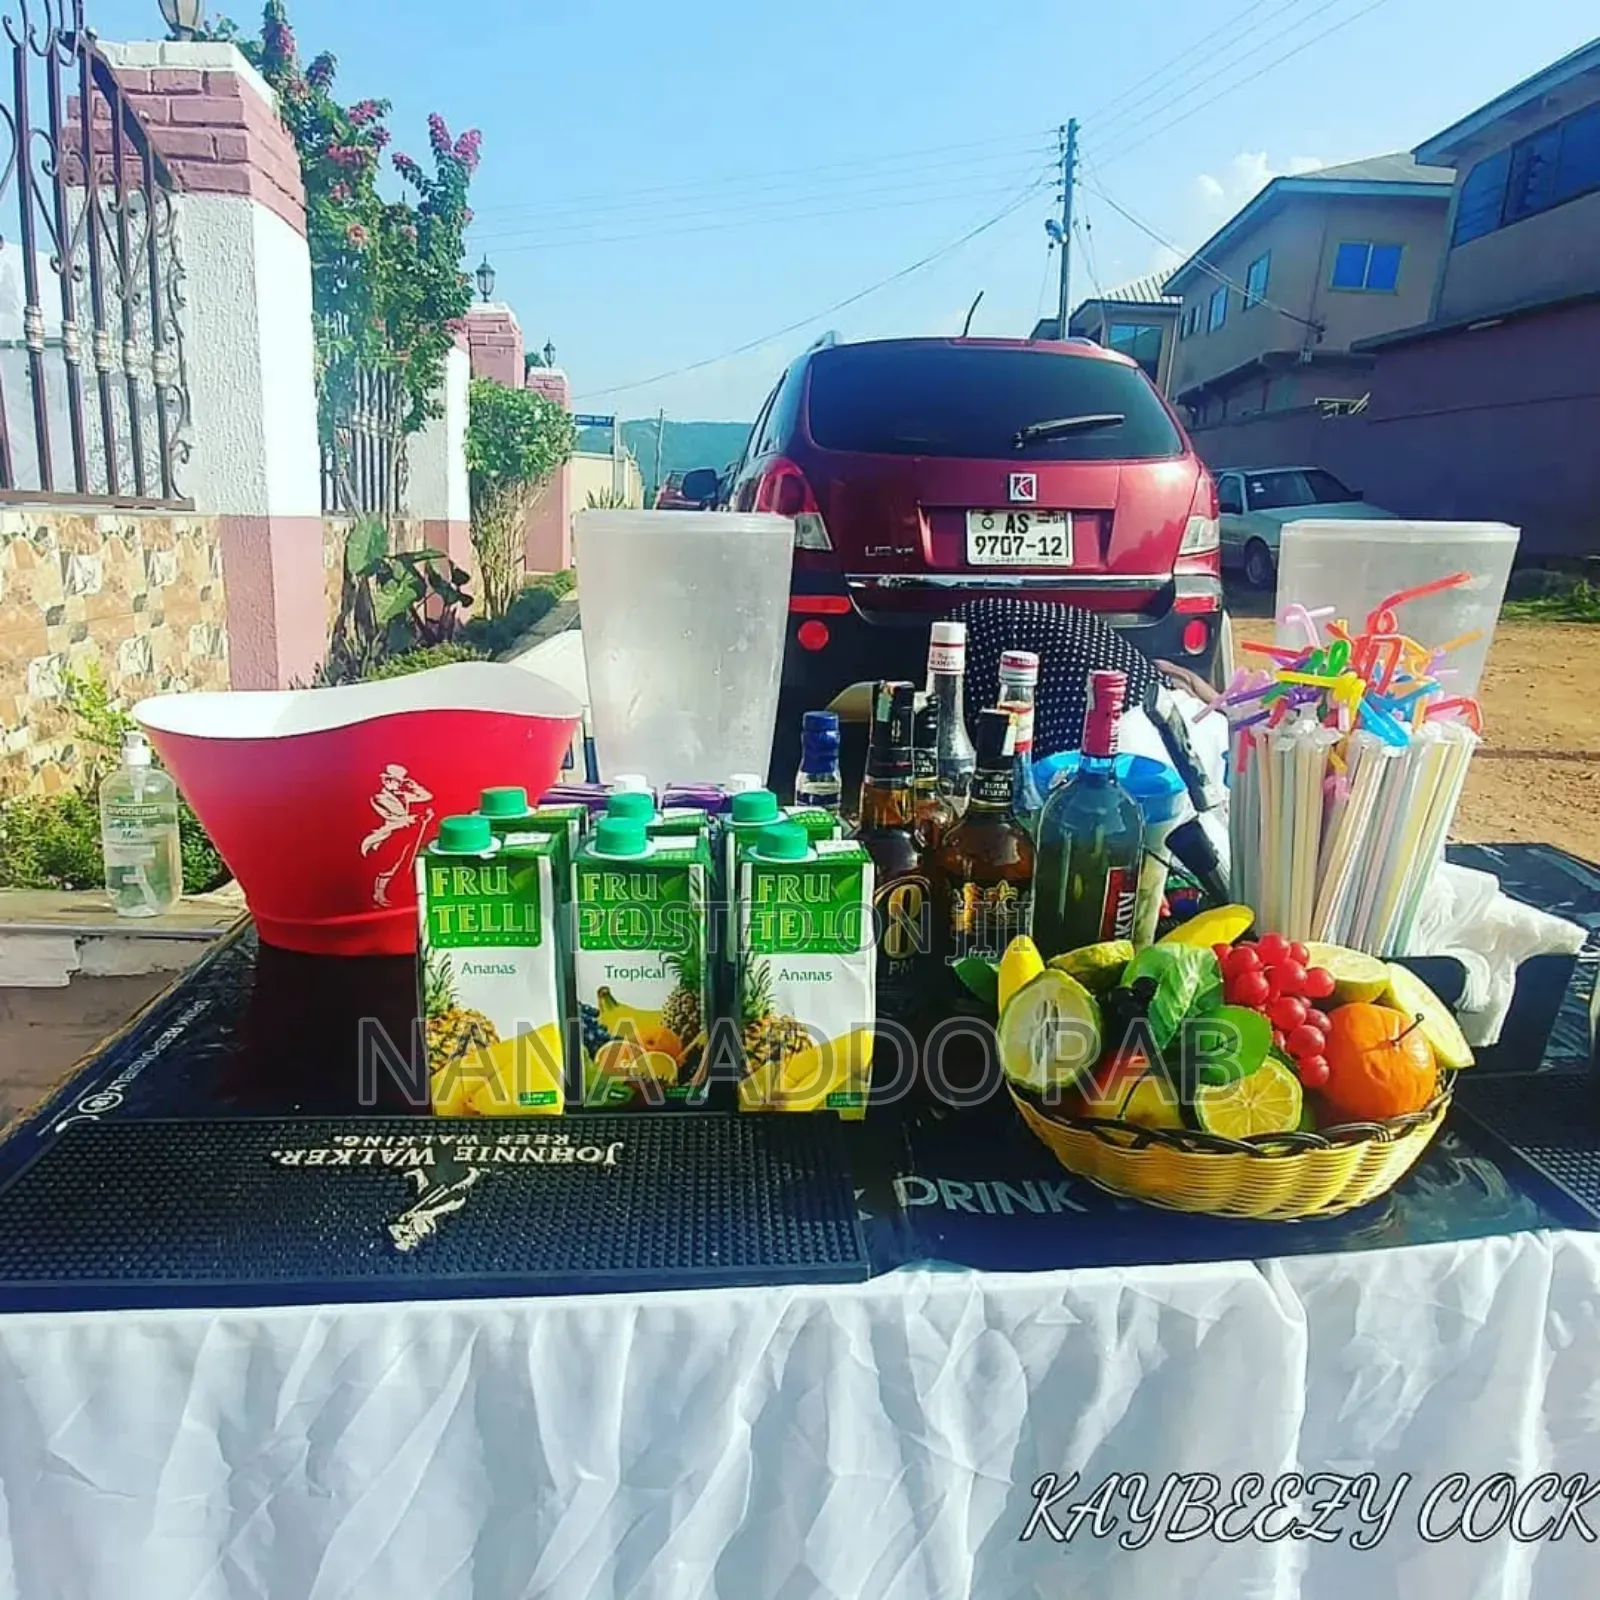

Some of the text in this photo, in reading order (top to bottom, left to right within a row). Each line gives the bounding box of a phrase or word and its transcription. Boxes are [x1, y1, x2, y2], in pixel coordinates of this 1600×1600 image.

[1005, 513, 1030, 534] AS
[975, 536, 1062, 556] 9707-12
[431, 866, 509, 896] FRU
[582, 873, 658, 902] FRU
[757, 873, 831, 903] FRU
[432, 903, 536, 934] TELLI
[461, 961, 517, 975] Ananas
[604, 965, 665, 981] Tropical
[779, 968, 833, 982] Ananas
[453, 1141, 625, 1166] JOHNNIE
[892, 1175, 1090, 1215] DRINK
